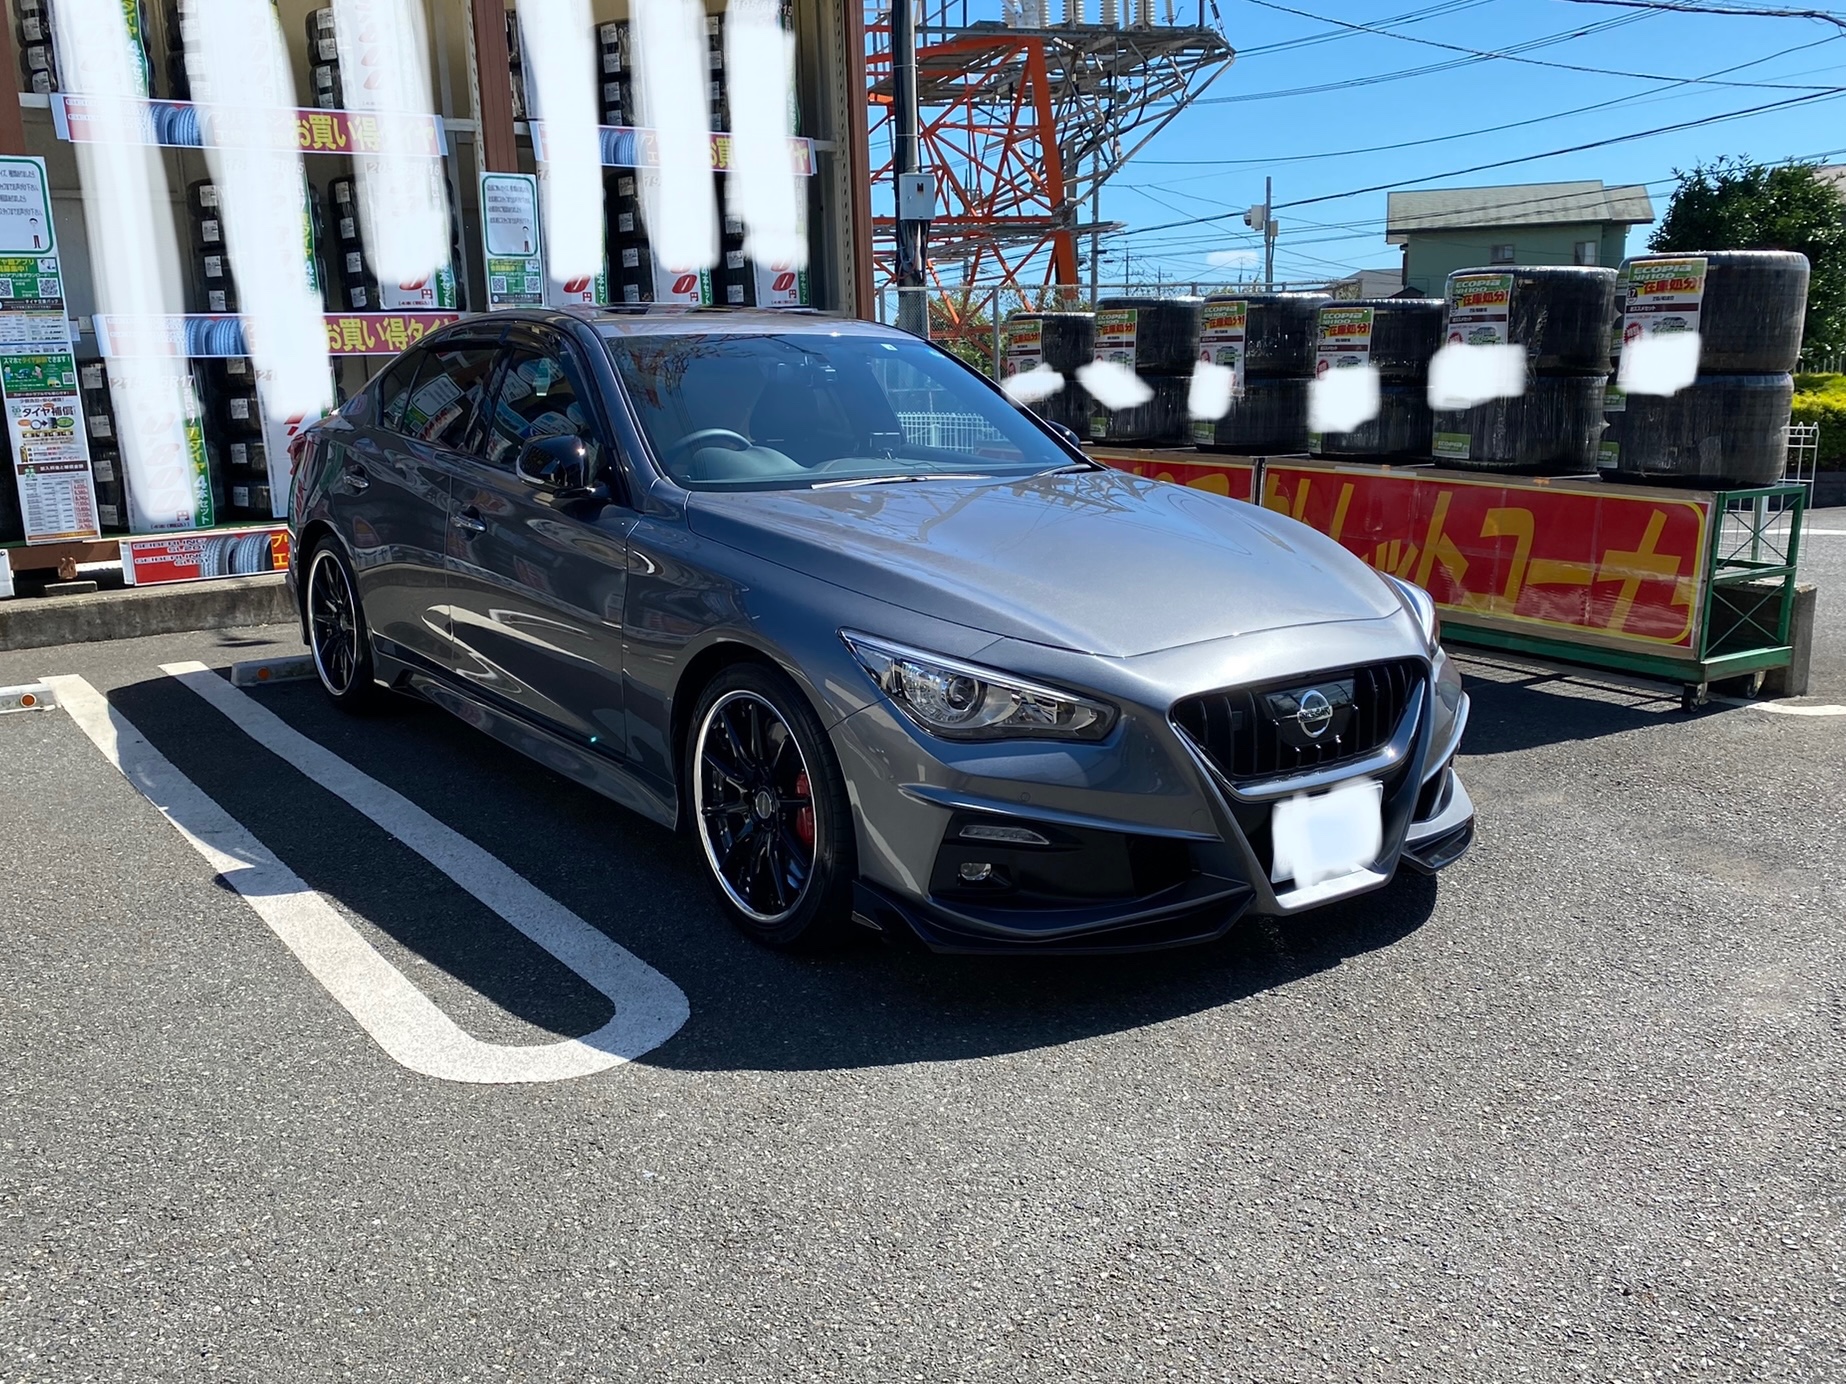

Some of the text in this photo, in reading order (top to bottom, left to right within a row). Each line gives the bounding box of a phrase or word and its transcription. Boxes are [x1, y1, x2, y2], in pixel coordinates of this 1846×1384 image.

[324, 317, 452, 352] お買い得タ
